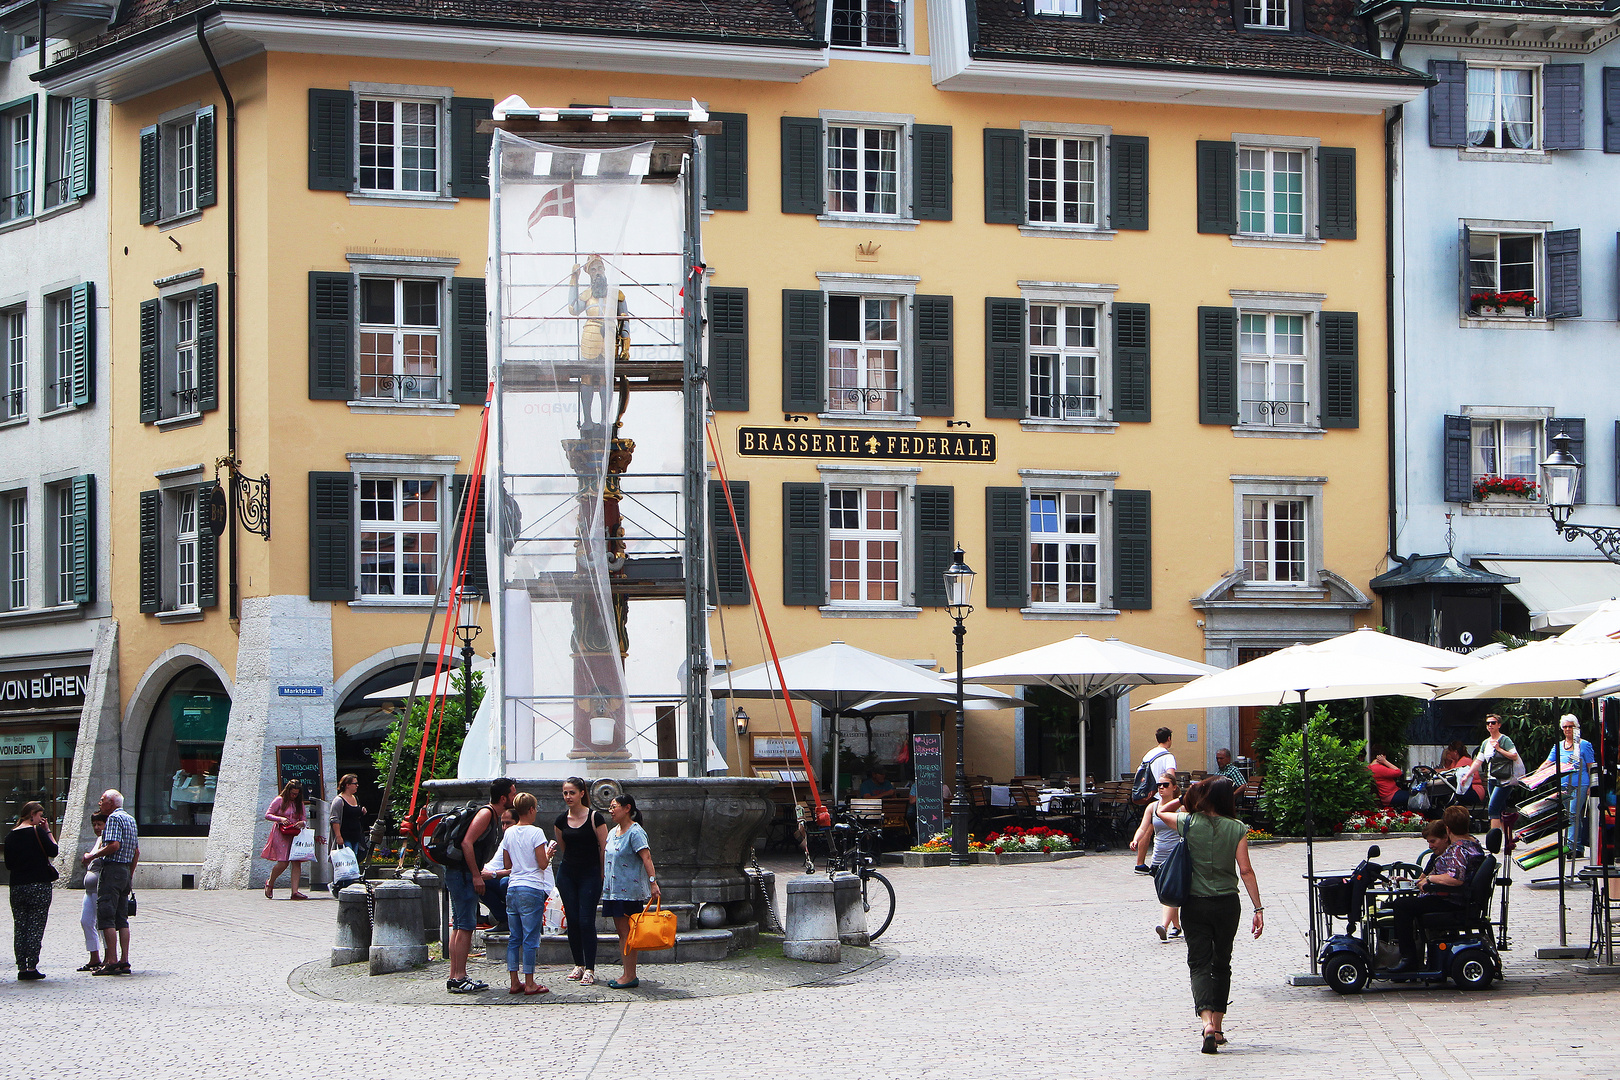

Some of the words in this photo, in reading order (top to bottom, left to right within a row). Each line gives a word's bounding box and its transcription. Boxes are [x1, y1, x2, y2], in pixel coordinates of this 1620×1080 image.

[744, 431, 860, 453] BRASSERIE
[886, 436, 991, 456] FEDERALE
[31, 672, 88, 699] BÜREN
[14, 743, 35, 754] BÜREN
